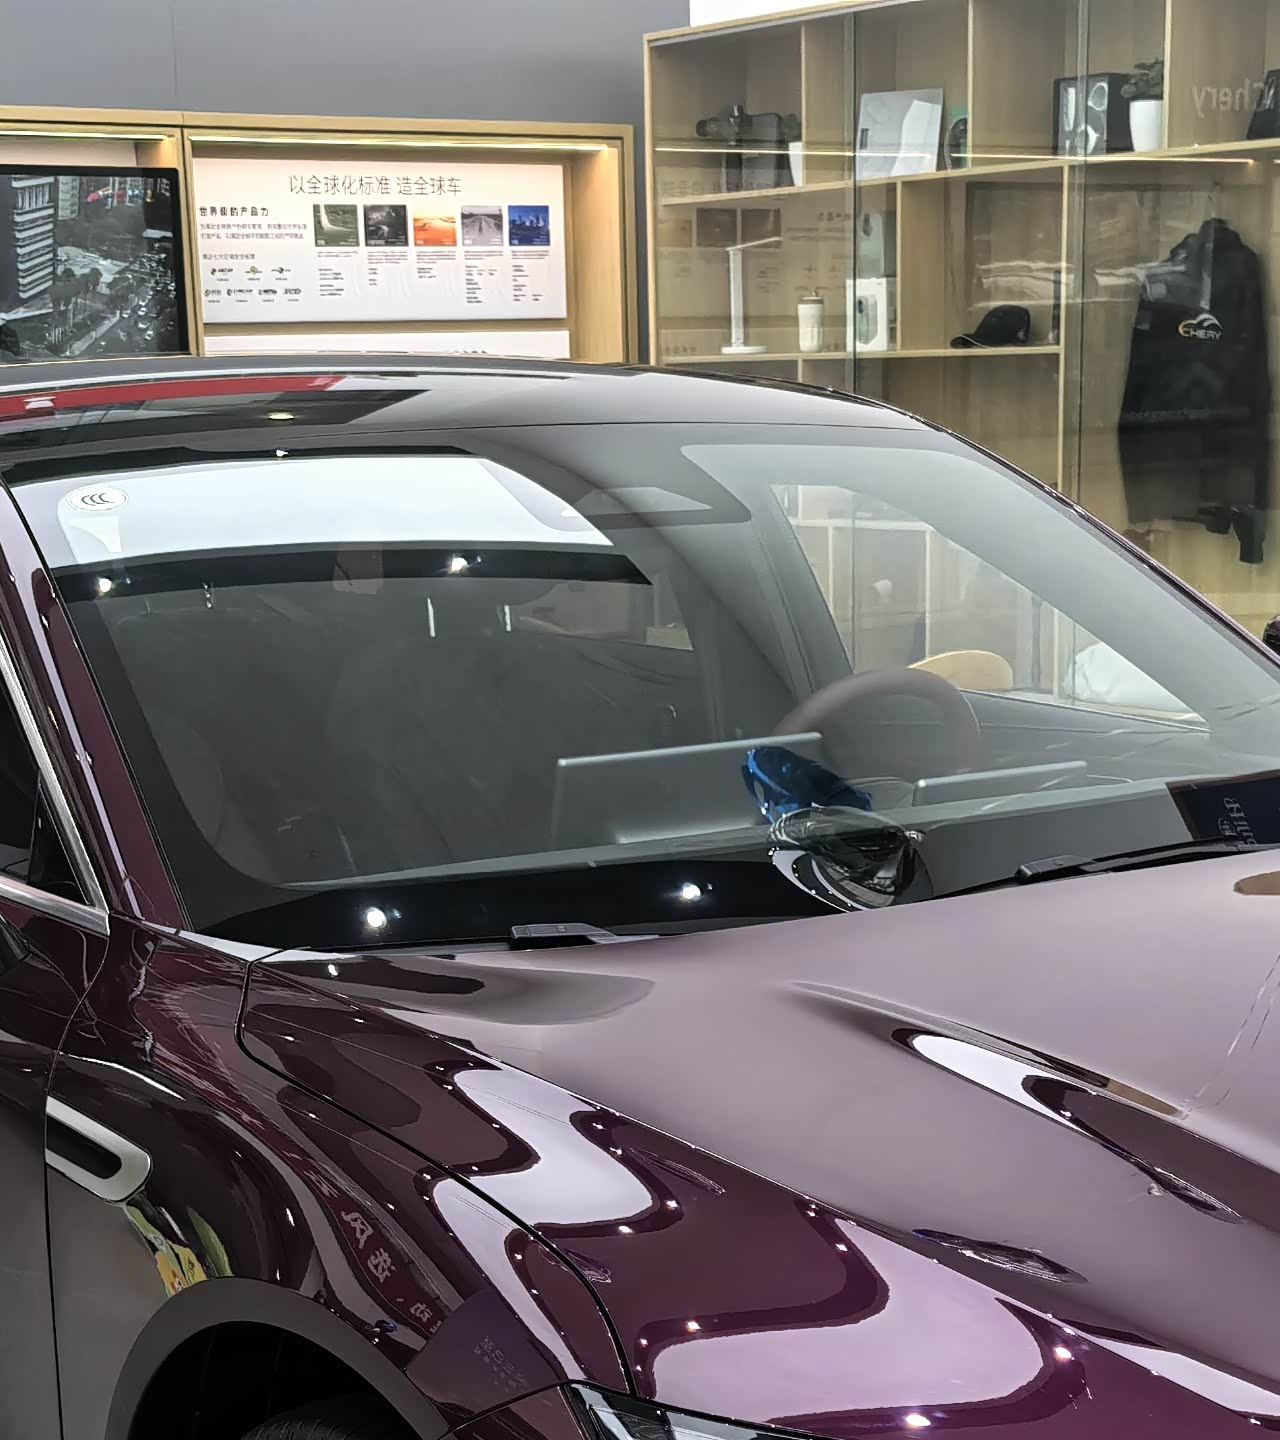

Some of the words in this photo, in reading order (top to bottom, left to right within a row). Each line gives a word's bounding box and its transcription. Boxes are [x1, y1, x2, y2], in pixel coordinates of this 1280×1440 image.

[289, 175, 391, 195] 以全球化标准
[396, 176, 462, 195] 造全球车
